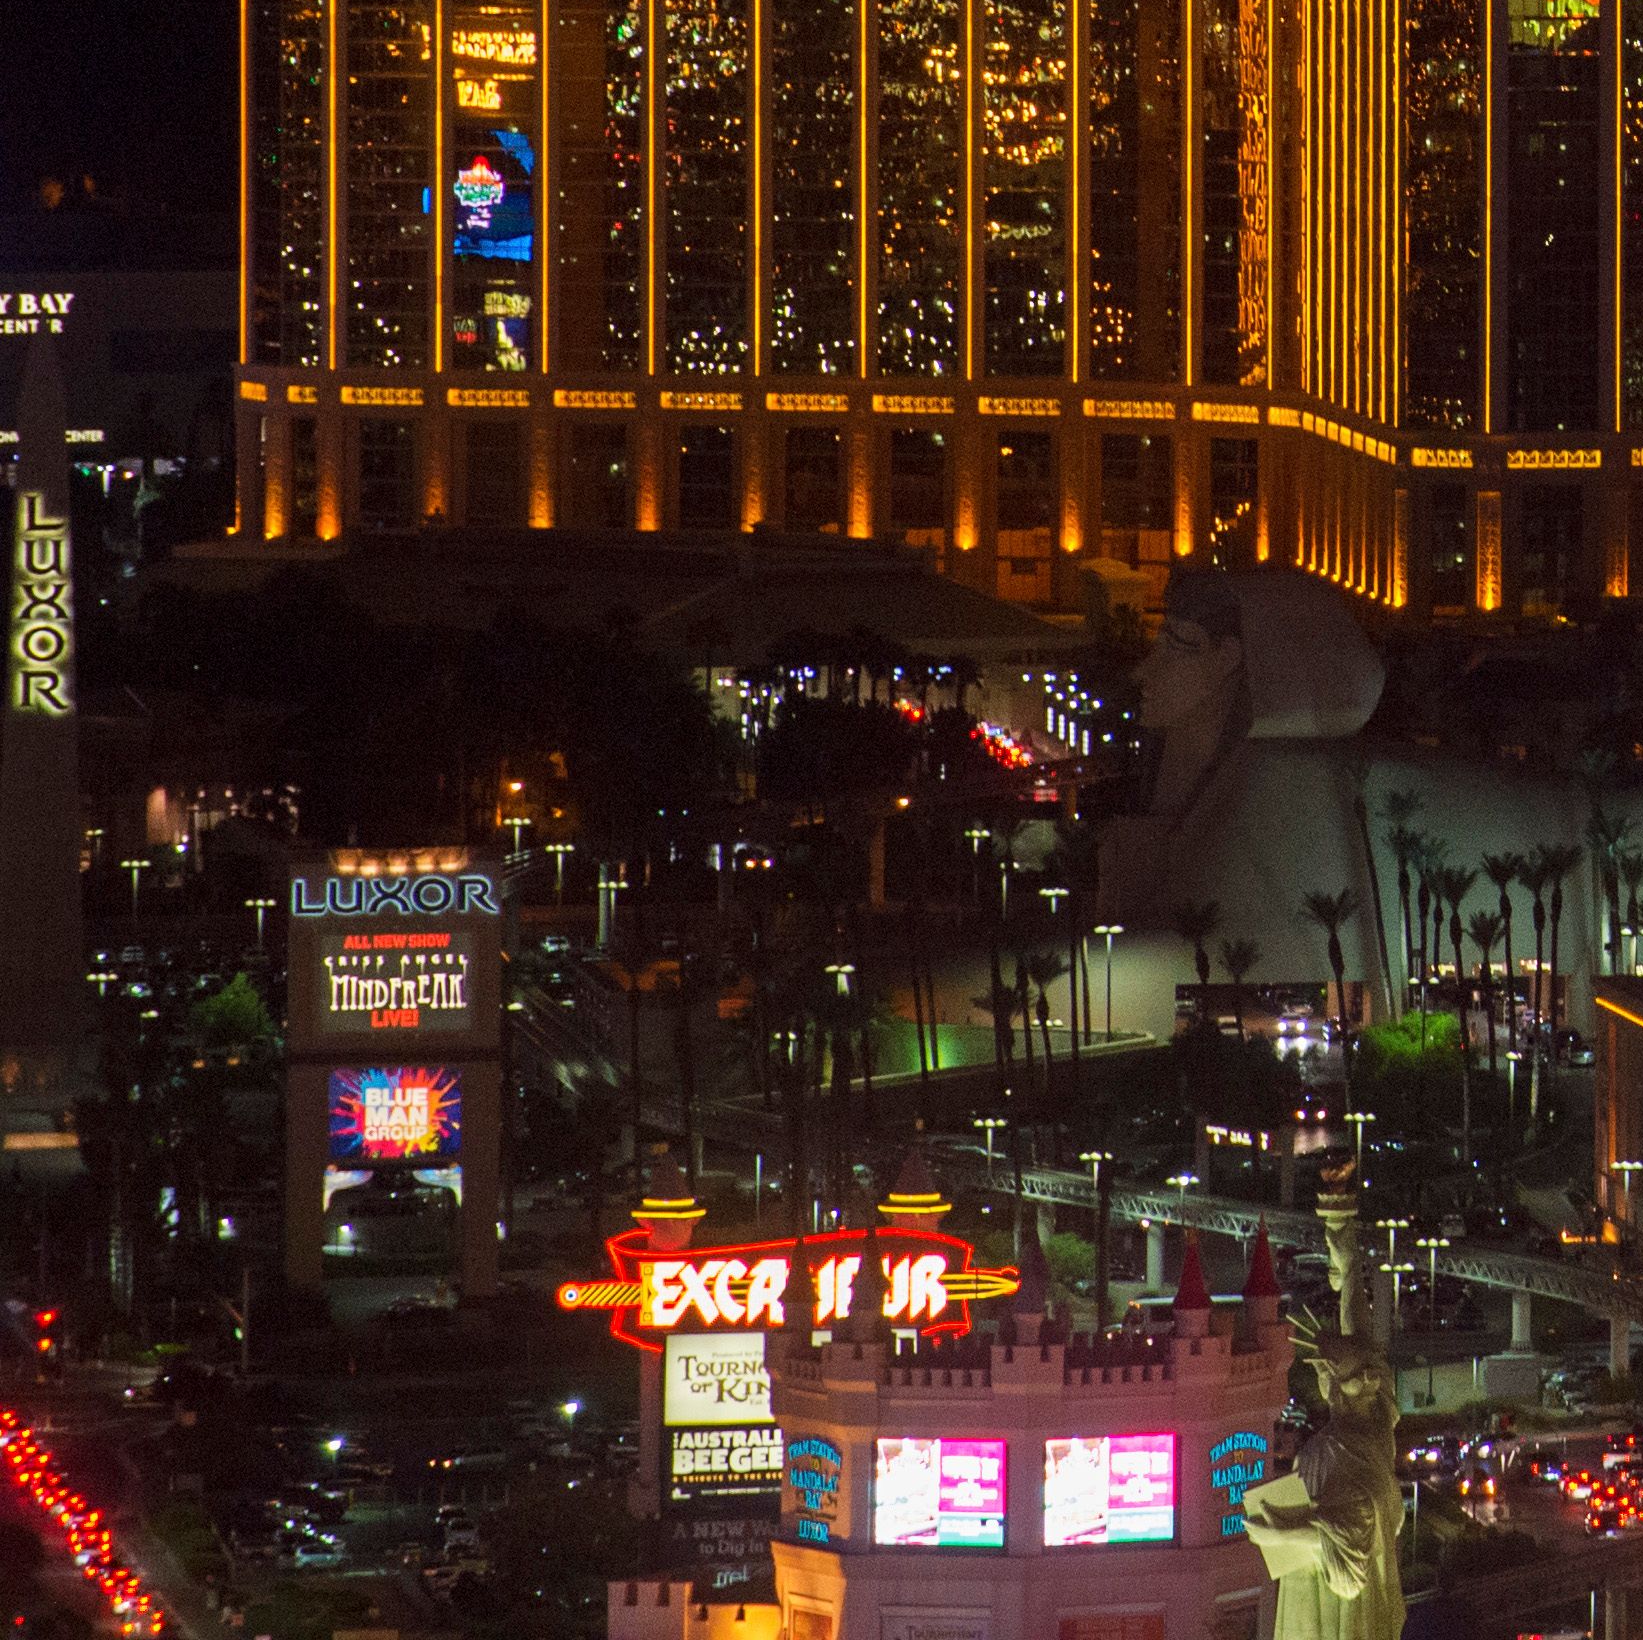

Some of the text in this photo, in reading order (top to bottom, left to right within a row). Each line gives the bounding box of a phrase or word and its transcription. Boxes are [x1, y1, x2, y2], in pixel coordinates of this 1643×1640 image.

[19, 293, 75, 314] BAY
[18, 494, 70, 712] LUXOR
[292, 875, 499, 917] LUXOR
[344, 933, 451, 950] ALL NEW SHOW
[330, 973, 467, 1011] MINDFREAK
[371, 1010, 420, 1028] LIVE!
[365, 1088, 428, 1106] BLUE
[365, 1106, 428, 1126] MAN
[365, 1126, 428, 1141] GROUP
[714, 1377, 771, 1404] KIN
[672, 1448, 729, 1475] BEE
[1211, 1459, 1265, 1488] MANDALAY
